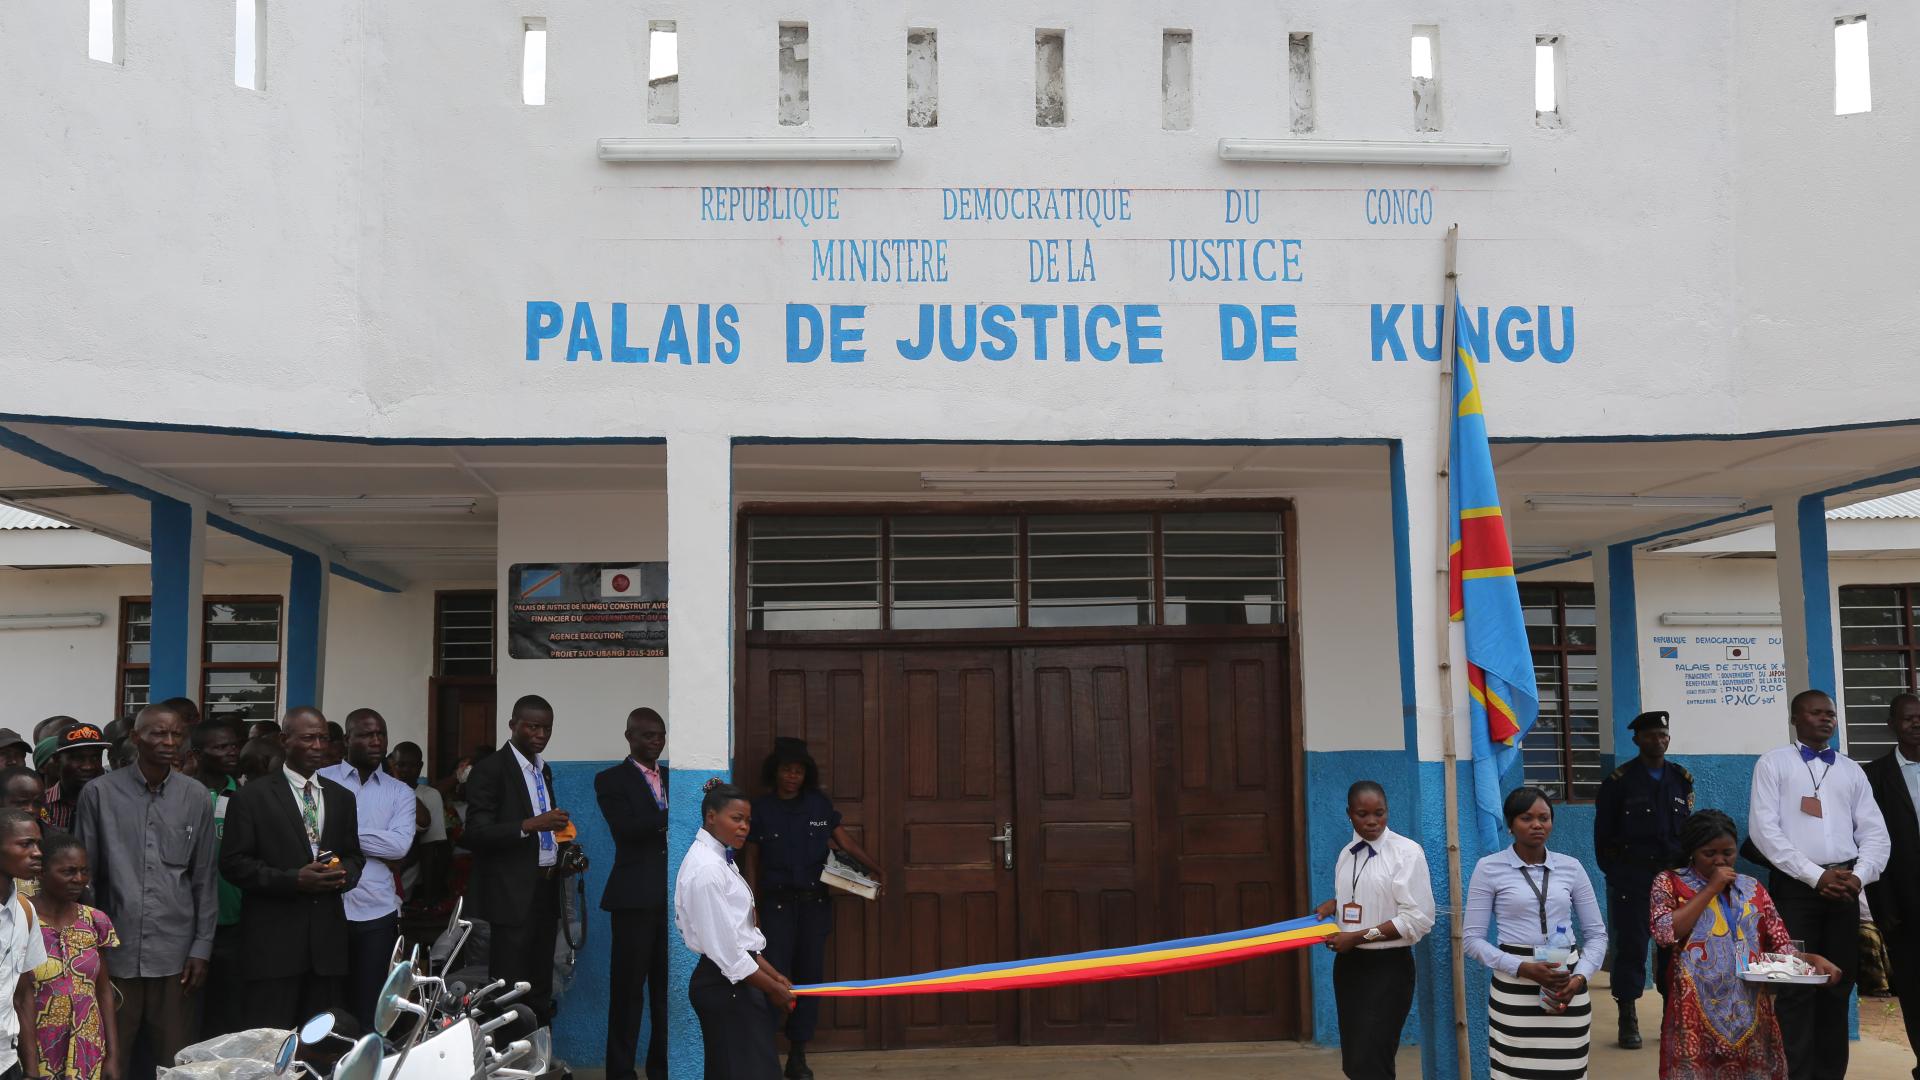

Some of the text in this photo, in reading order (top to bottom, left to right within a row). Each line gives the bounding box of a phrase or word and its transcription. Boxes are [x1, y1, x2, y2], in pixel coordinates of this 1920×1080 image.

[701, 187, 1433, 228] REPUBLIQUE DEMOCRATIQUE DU CONGO
[811, 239, 949, 283] MINISTERE
[1168, 239, 1304, 283] JUSTICE
[525, 301, 1576, 366] PALAIS DE JUSTICE DE KUNGU
[609, 602, 651, 610] CONSTRUIT
[549, 632, 579, 641] AGENCE
[1653, 636, 1782, 645] REPUBLIQUE DEMOCRATIQUE DU
[551, 650, 578, 658] PROJET
[578, 650, 625, 658] SUD-UBANGI
[1675, 663, 1710, 671] PALAIS
[1716, 663, 1730, 671] DE
[1731, 663, 1767, 671] JUSTICE
[1724, 694, 1761, 706] PMC
